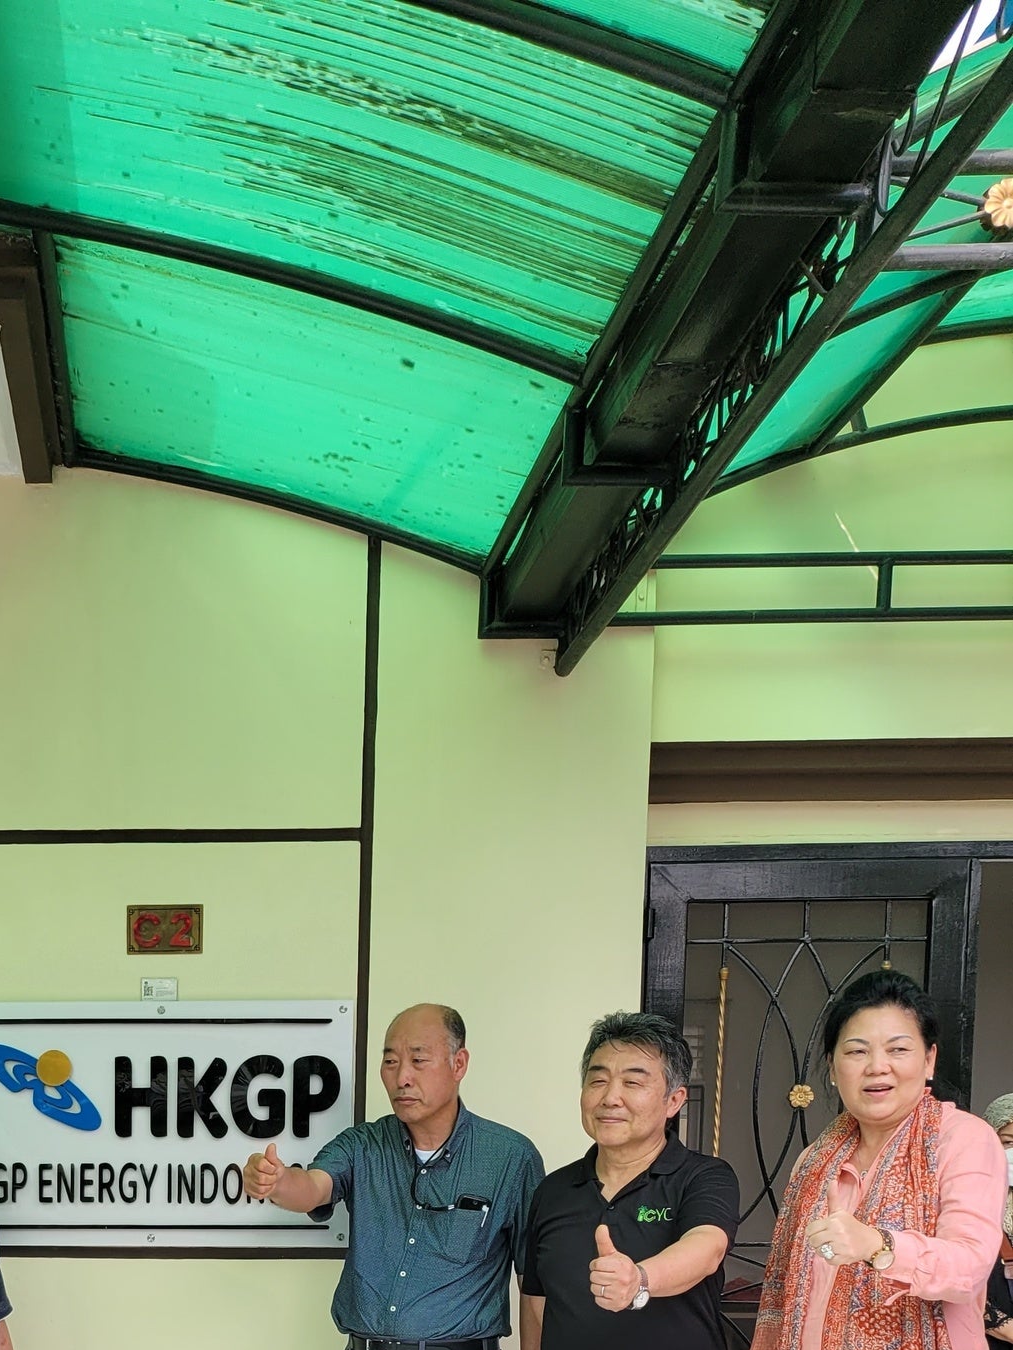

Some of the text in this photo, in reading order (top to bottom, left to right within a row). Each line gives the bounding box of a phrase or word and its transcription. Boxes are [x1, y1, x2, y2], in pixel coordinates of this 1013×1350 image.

[114, 1054, 341, 1140] HKGP
[38, 1162, 158, 1204] ENERGY
[167, 1162, 303, 1205] INDO
